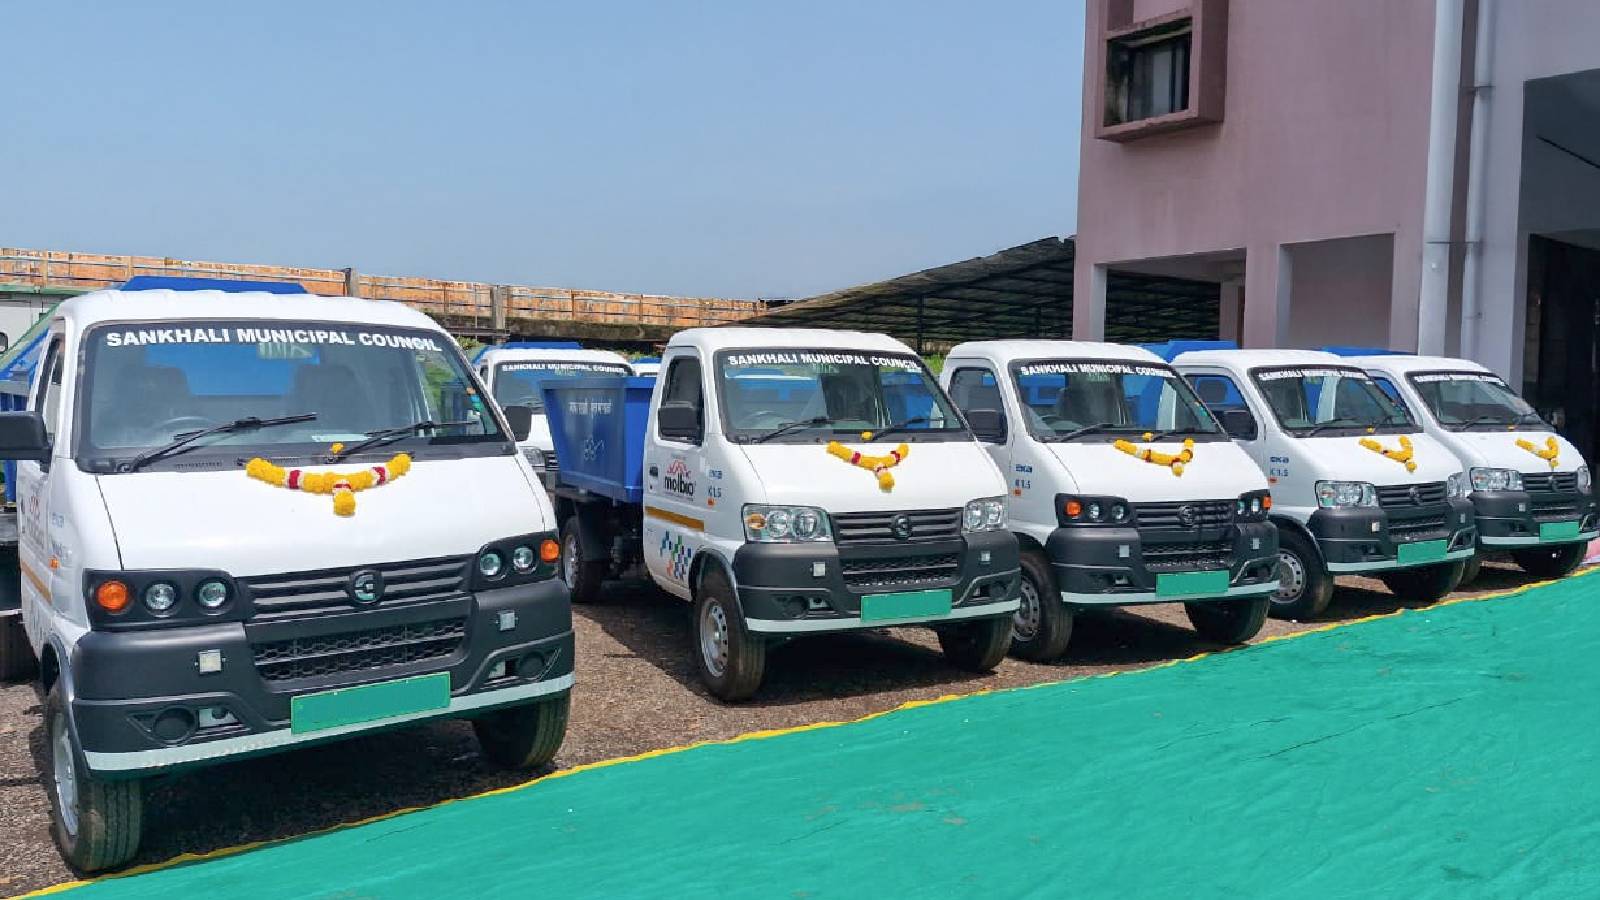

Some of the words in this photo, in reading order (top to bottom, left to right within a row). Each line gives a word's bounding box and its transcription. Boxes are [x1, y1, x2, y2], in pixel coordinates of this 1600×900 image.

[106, 328, 230, 347] SANKHALI
[237, 328, 355, 345] MUNICIPAL
[358, 332, 442, 351] COUNCIL
[728, 353, 798, 366] SANKHALI
[801, 354, 869, 365] MUNICIPAL
[871, 357, 922, 369] COUNCIL
[664, 472, 694, 496] molbio
